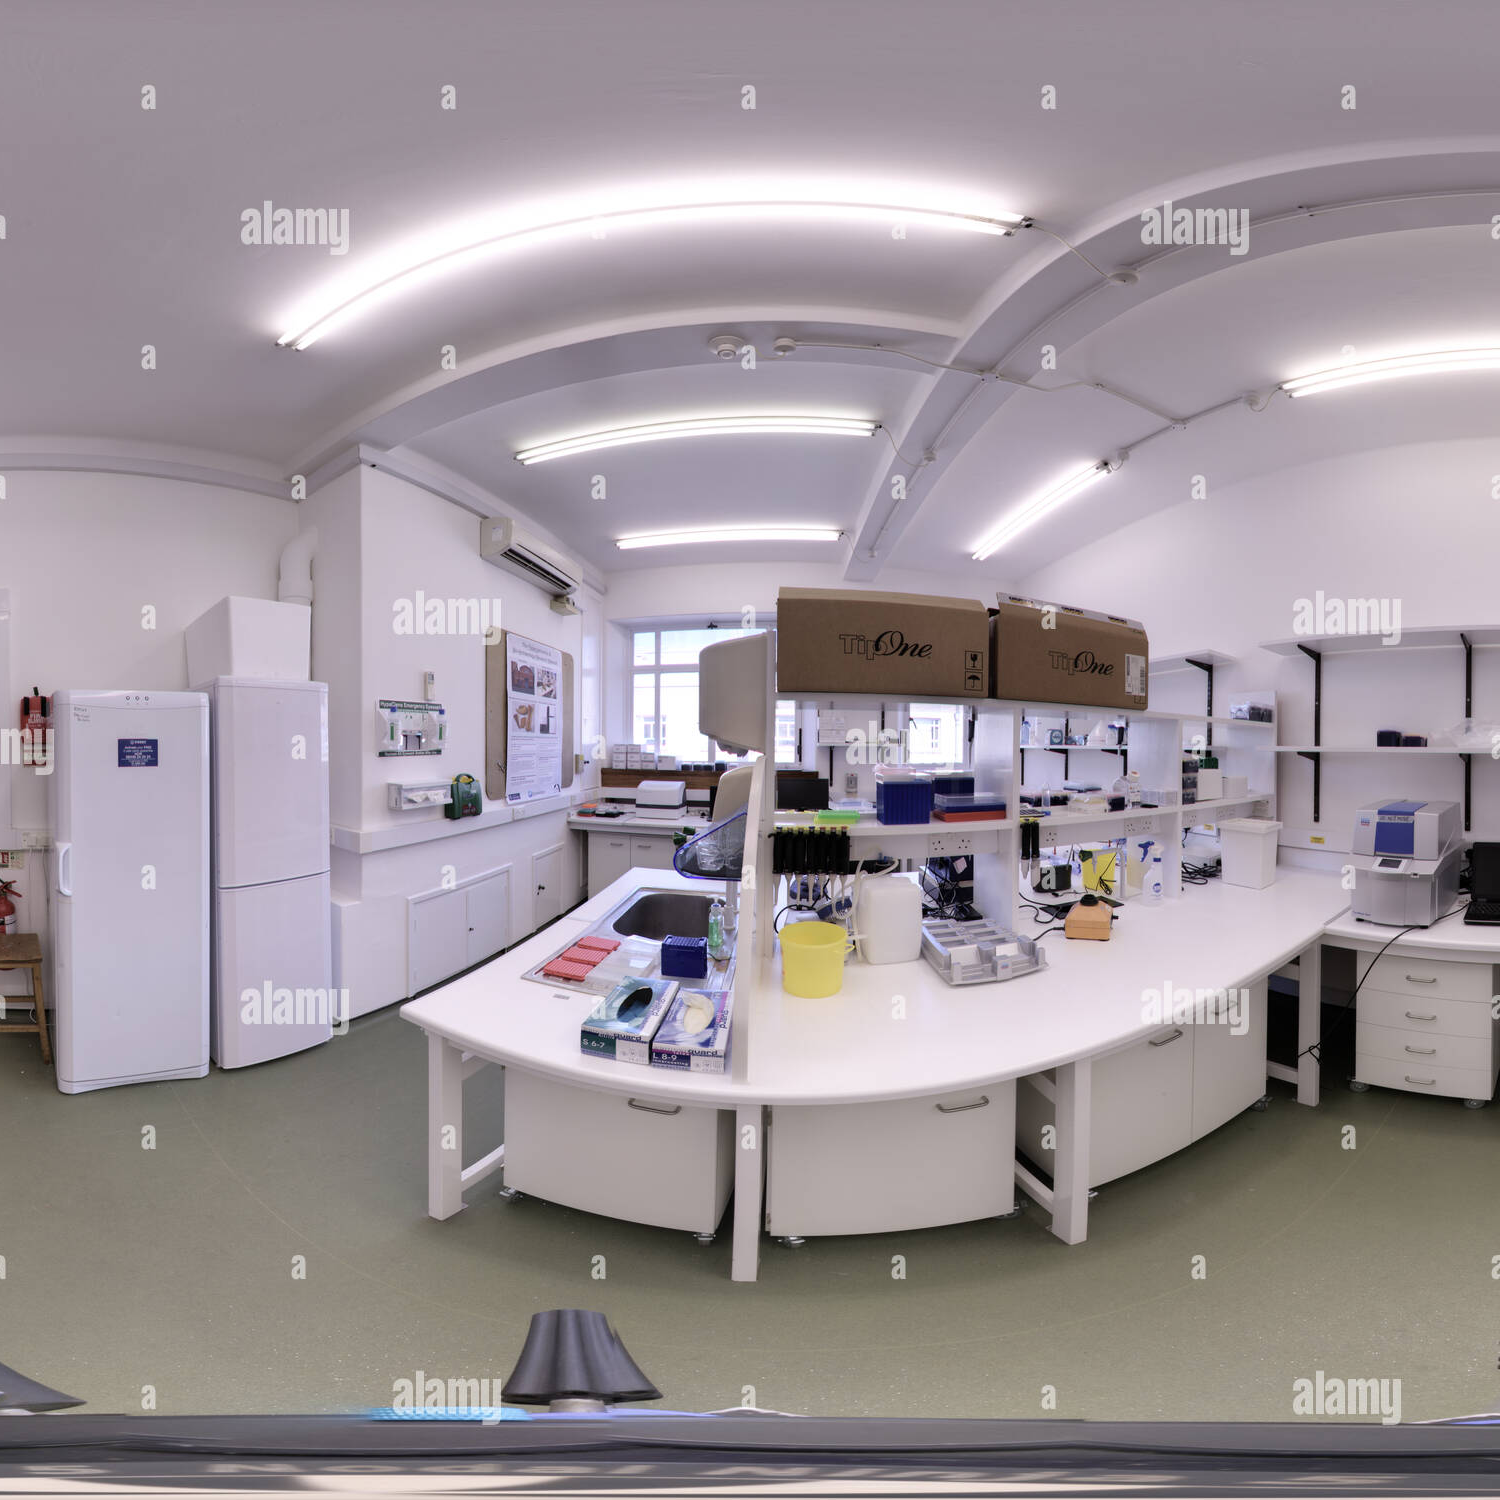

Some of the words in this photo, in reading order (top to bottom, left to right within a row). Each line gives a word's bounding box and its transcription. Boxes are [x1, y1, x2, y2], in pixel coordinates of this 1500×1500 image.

[838, 630, 933, 661] TipOne
[1048, 650, 1114, 676] TipOne
[582, 1038, 589, 1046] S
[591, 1040, 605, 1048] 6-7
[661, 1053, 678, 1061] 8-9
[24, 1465, 108, 1475] 5
[204, 1463, 653, 1475] Nodal
[695, 1466, 1188, 1482] Ninja
[1244, 1475, 1415, 1485] 5
